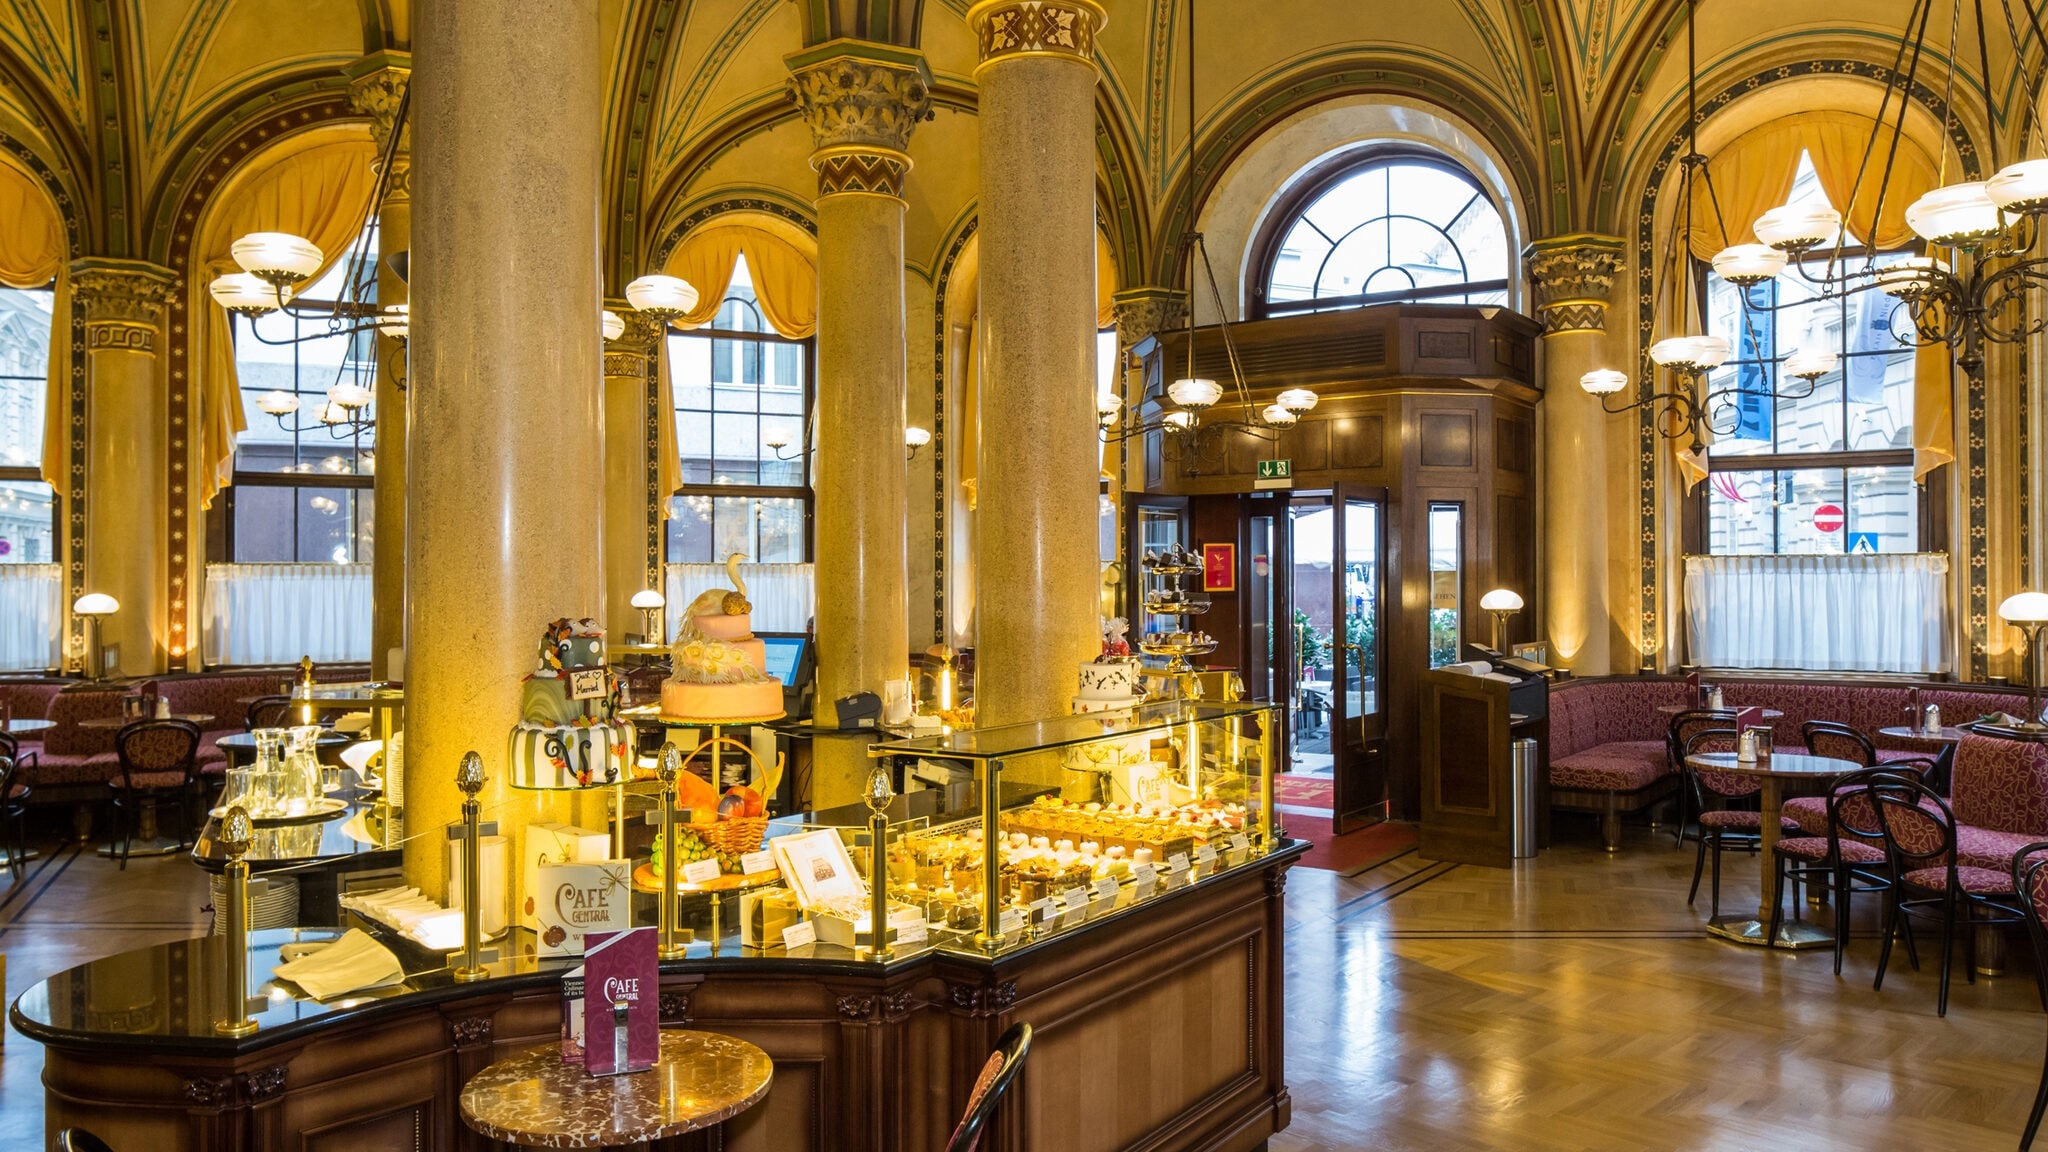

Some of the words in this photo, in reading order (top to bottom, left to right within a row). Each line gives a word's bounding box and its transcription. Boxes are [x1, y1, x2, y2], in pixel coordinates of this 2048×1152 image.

[555, 883, 608, 928] CAFE
[572, 909, 611, 923] CENTRAL
[604, 976, 639, 1004] CAFE
[615, 992, 639, 1001] CENTRAL
